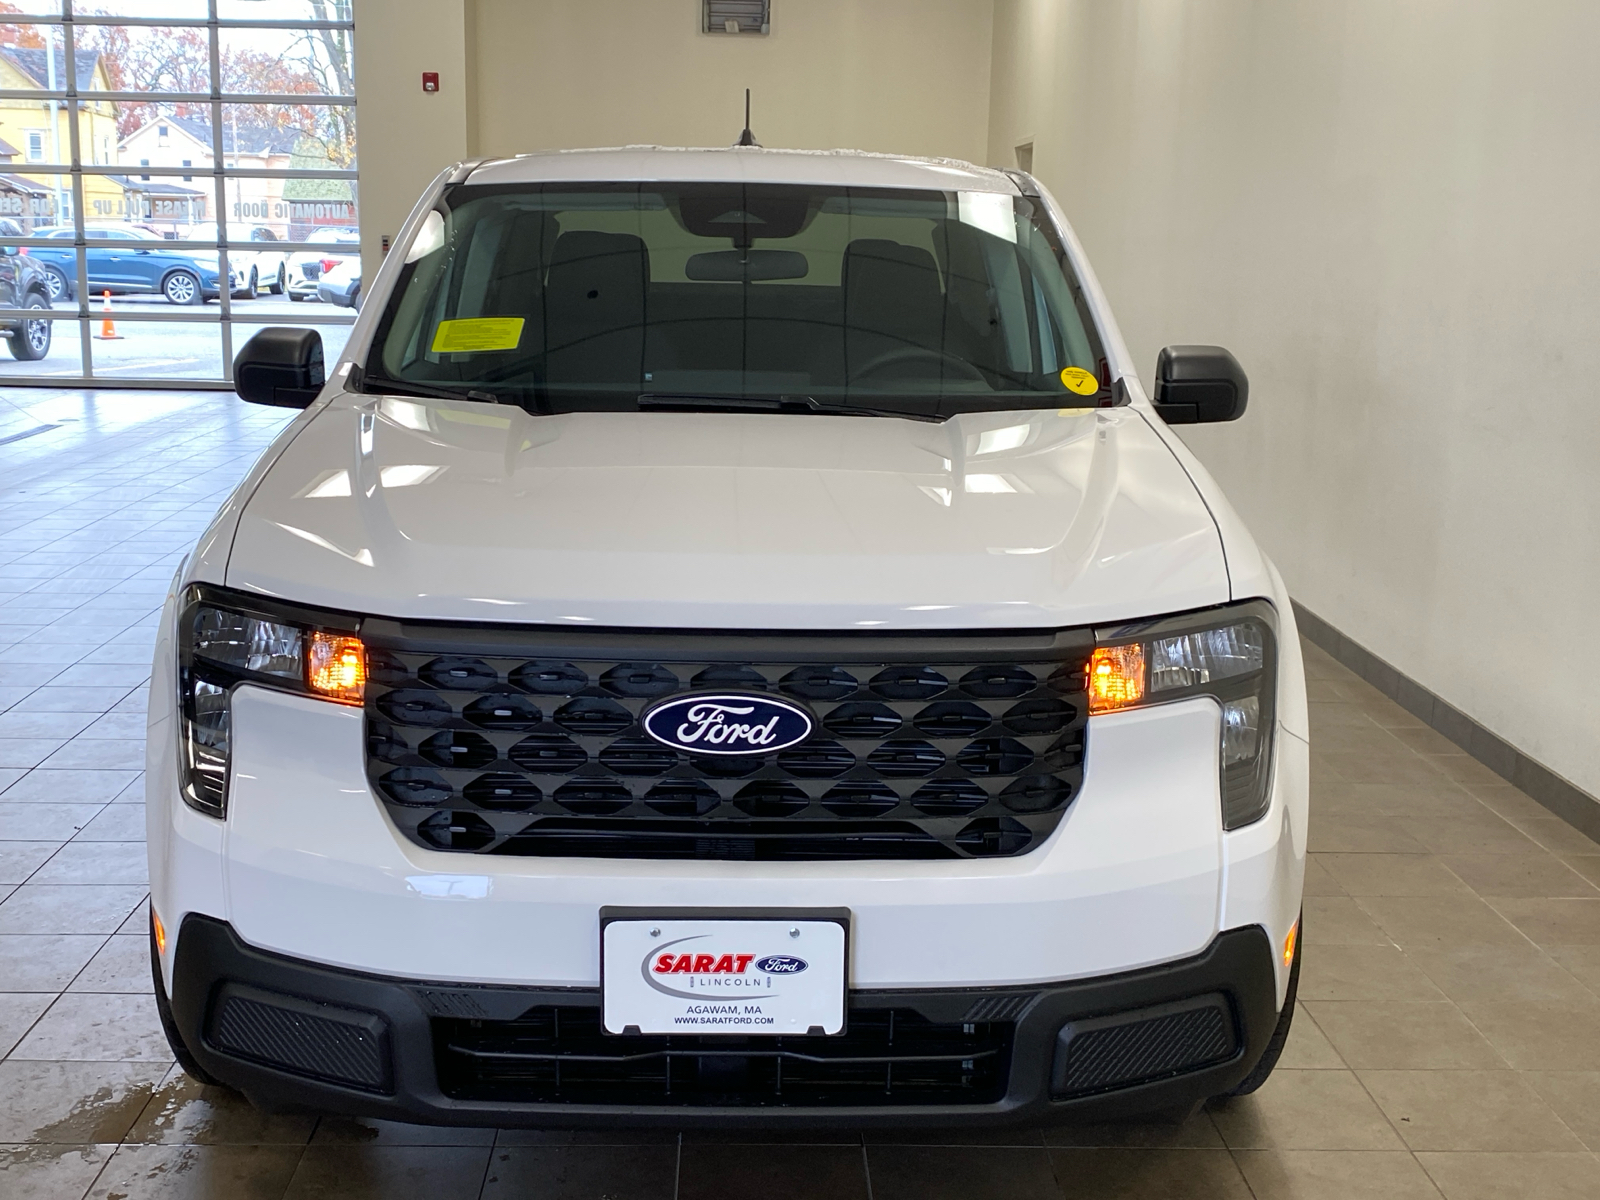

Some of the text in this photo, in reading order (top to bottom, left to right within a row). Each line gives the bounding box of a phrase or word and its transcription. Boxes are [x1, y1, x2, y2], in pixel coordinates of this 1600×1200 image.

[676, 703, 780, 745] Ford
[653, 953, 799, 974] SARAT Ford
[700, 978, 761, 986] LINCOLN
[686, 1005, 762, 1015] AGAWAM, MA
